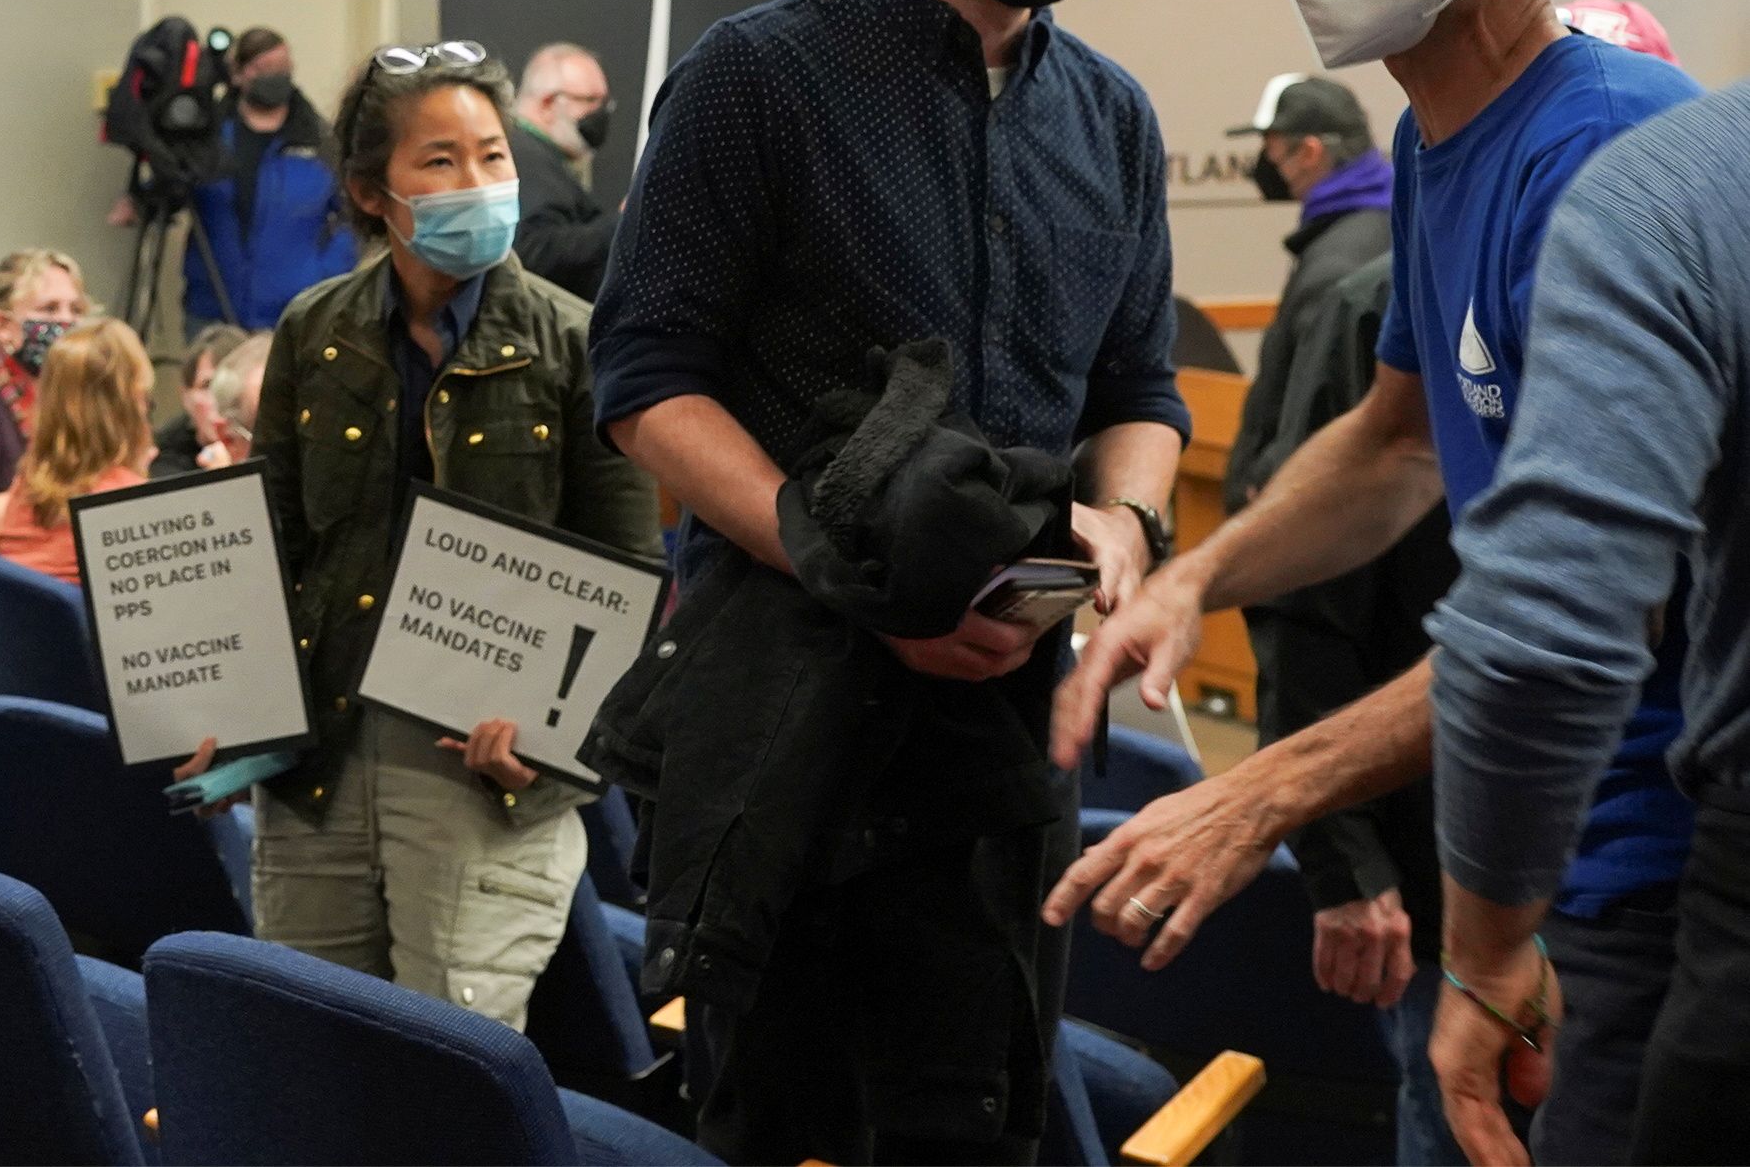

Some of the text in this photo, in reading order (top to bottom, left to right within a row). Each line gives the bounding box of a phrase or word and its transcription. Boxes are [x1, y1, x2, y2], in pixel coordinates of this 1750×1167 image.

[101, 510, 215, 547] BULLYING &
[105, 528, 253, 572] COERCION HAS
[110, 559, 231, 595] NO PLACE IN
[424, 527, 630, 615] LOUD AND CLEAR:
[113, 600, 153, 621] PPS
[407, 584, 547, 650] NO VACCINE
[121, 633, 243, 670] NO VACCINE
[398, 613, 524, 673] MANDATES
[126, 663, 223, 695] MANDATE
